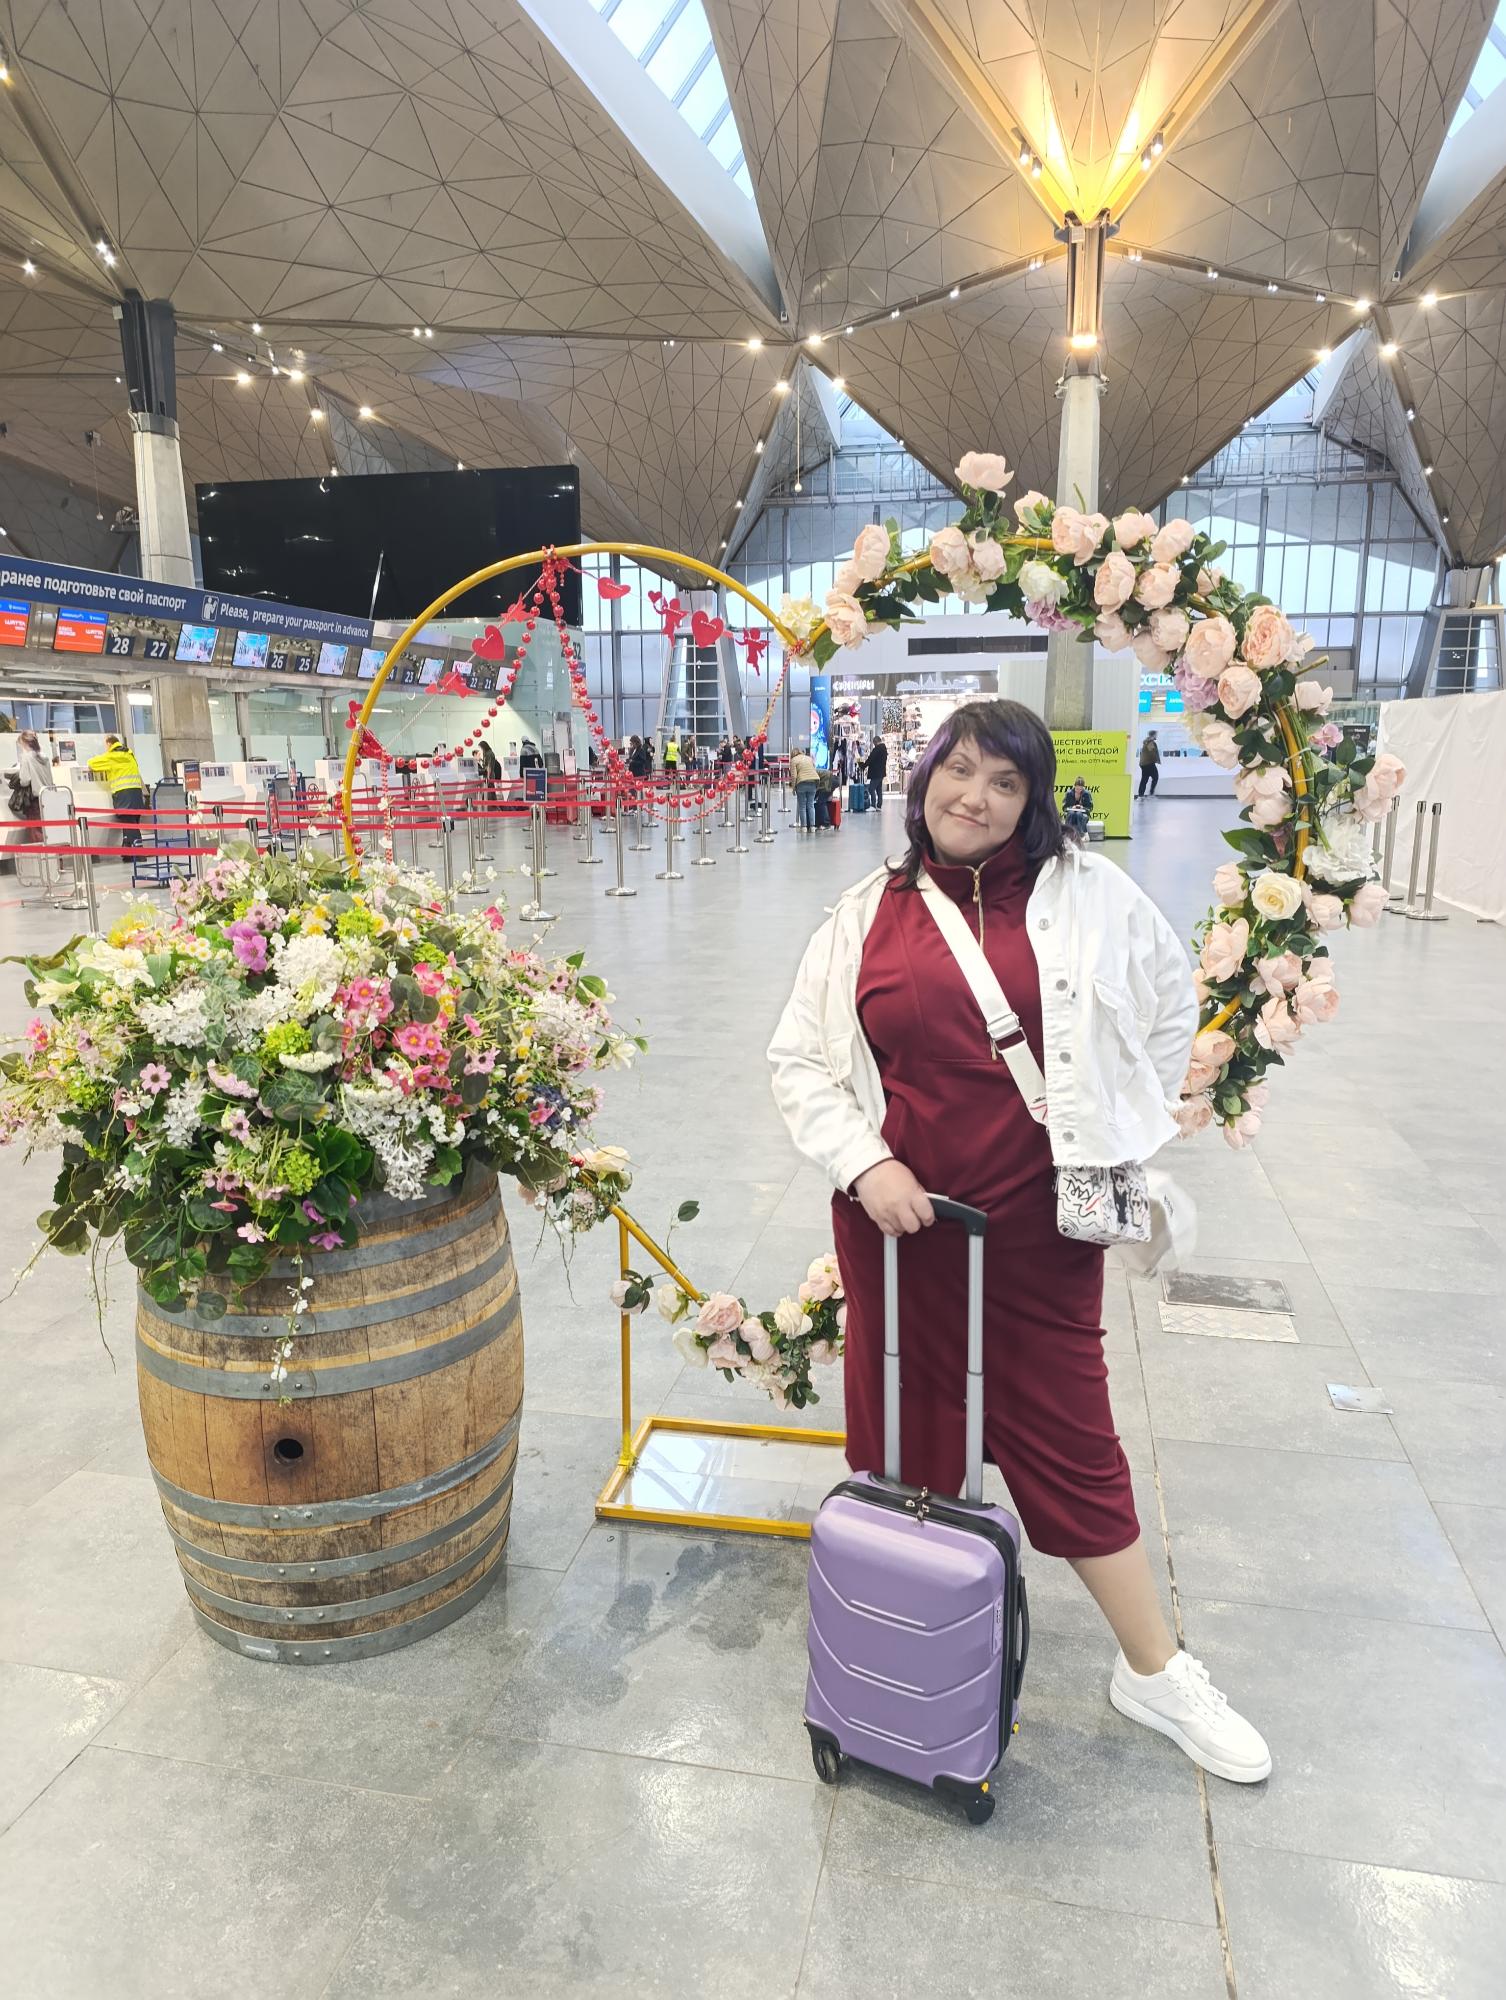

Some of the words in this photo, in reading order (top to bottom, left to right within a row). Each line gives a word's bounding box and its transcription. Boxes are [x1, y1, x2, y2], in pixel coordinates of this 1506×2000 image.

[0, 569, 42, 588] ранее
[43, 577, 116, 599] подготовьте
[118, 588, 144, 603] свой
[145, 593, 187, 611] паспорт
[220, 603, 250, 620] Please,
[252, 610, 284, 625] prepare
[284, 616, 303, 628] your
[303, 619, 335, 633] passport
[335, 622, 342, 633] in
[342, 624, 369, 638] advance
[111, 637, 129, 654] 28
[150, 641, 167, 657] 27
[270, 655, 284, 669] 26
[298, 658, 311, 672] 25
[404, 671, 414, 683] 23
[469, 677, 478, 688] 22
[484, 678, 492, 689] 21
[1075, 746, 1119, 755] ВЫГОДОЙ
